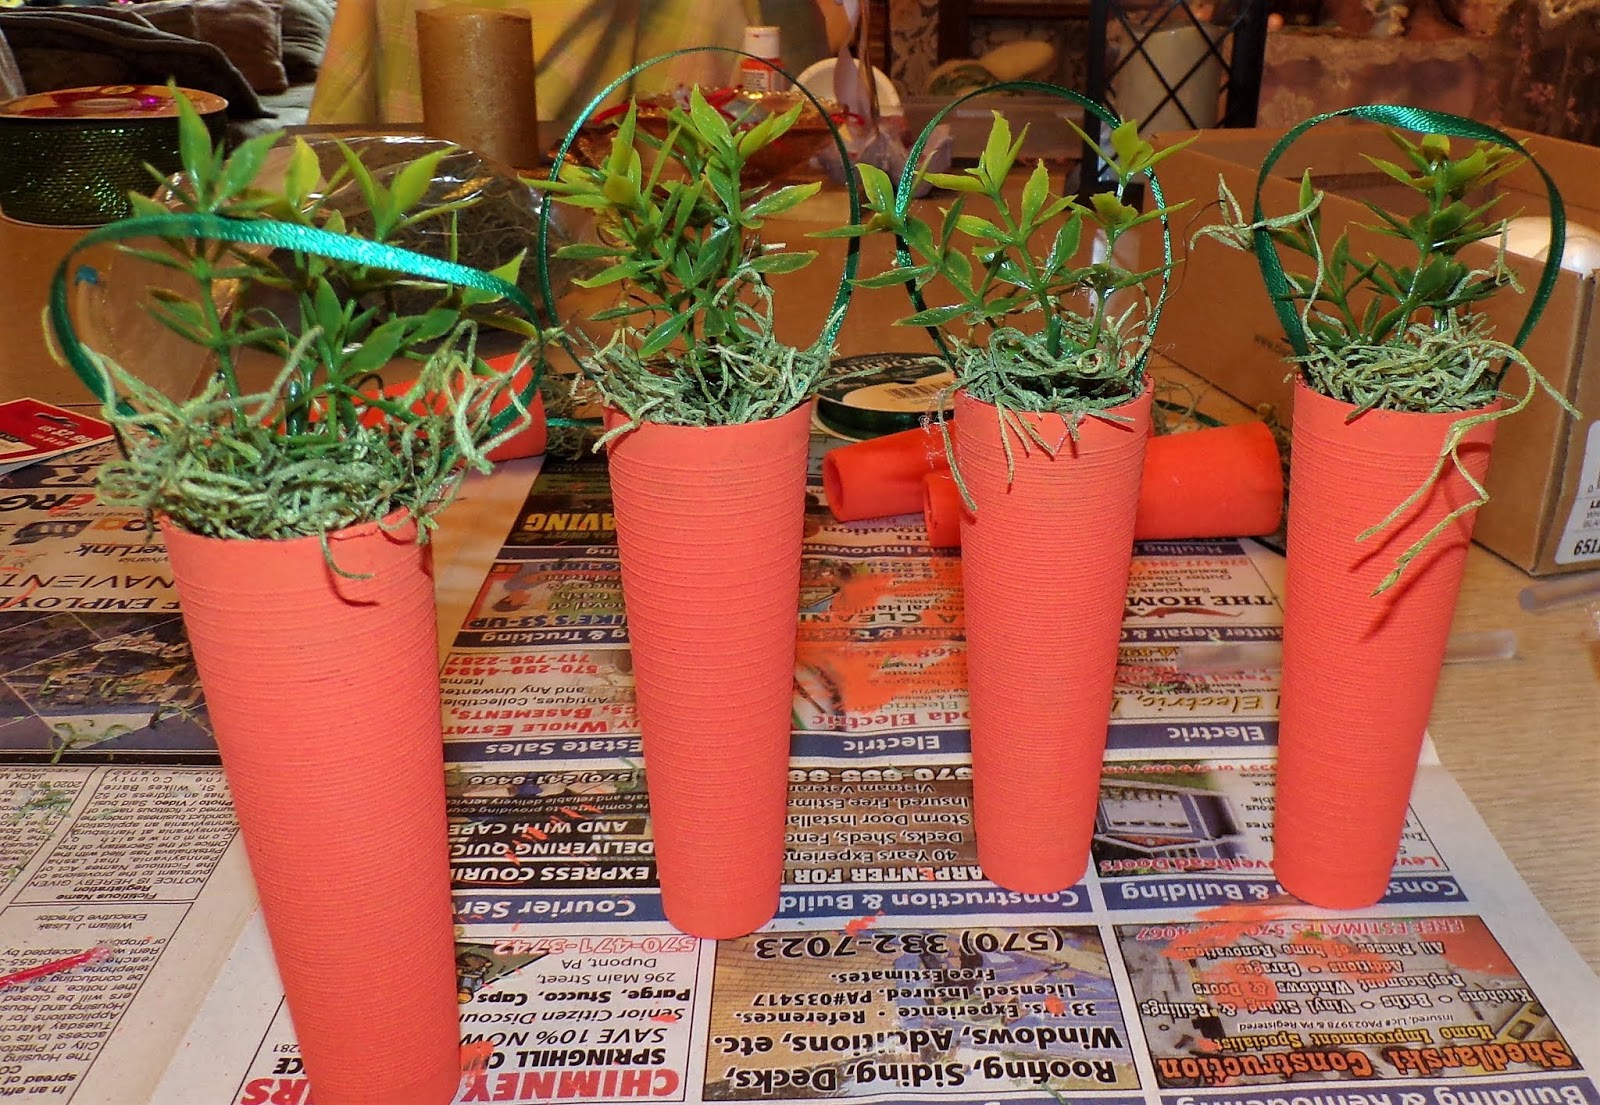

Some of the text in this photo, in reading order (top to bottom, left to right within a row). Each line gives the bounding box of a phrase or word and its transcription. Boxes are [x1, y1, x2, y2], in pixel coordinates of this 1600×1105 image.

[1146, 543, 1222, 554] Hauling
[1210, 595, 1273, 606] THE
[554, 613, 625, 628] IKE'S
[482, 628, 582, 644] Trucking
[1153, 626, 1221, 640] Repair
[520, 684, 585, 695] and Any
[532, 695, 608, 705] Antiques,
[1136, 694, 1264, 713] Electric,
[811, 712, 918, 731] Electric
[1167, 726, 1265, 742] Electric
[483, 738, 644, 757] Estate Sales
[843, 735, 940, 754] Electric
[859, 783, 935, 793] Vietnam
[491, 796, 543, 806] delivery
[850, 796, 968, 809] Insured. Free
[478, 804, 542, 816] providing
[74, 821, 141, 829] application
[862, 813, 970, 826] Storm Door
[158, 826, 236, 835] Pennsylvania
[576, 820, 628, 834] AND
[833, 830, 962, 846] Decks, Sheds,
[95, 842, 154, 851] Secretary
[512, 839, 654, 856] DELIVERING
[129, 854, 220, 862] Pennsylvania,
[878, 850, 957, 863] 40 Years
[134, 862, 191, 870] Fictitious
[1099, 857, 1169, 873] Doors
[50, 868, 211, 879] pursuant provisions
[541, 865, 649, 882] EXPRESS
[793, 867, 843, 884] FOR
[27, 876, 206, 888] NOTICE HEREBY GIVEN
[73, 884, 152, 892] Registration
[1121, 882, 1243, 902] Building
[862, 890, 1079, 912] Construction &
[518, 899, 636, 918] Courier
[34, 913, 148, 922] Executive Director
[37, 922, 133, 931] William Lisak
[1290, 919, 1465, 937] FREE ESTIMATES
[492, 936, 697, 956] 570-471-3742
[754, 929, 1064, 960] (570) 332-7023
[1357, 941, 1445, 955] All Phases
[26, 947, 160, 957] Rent accepted
[81, 964, 149, 974] telephone.
[561, 956, 657, 971] Dupont, PA
[50, 973, 123, 984] conducting
[536, 972, 676, 987] 296 Main Street,
[831, 967, 996, 985] Free Estimates.
[33, 983, 137, 994] ther notice. The
[1191, 972, 1465, 997] Replacement Windows Doors
[2, 992, 132, 1003] ers will closed
[476, 986, 691, 1007] Parge, Stucco, Caps
[752, 984, 1076, 1008] Licensed. Insured. PA#035417
[1140, 987, 1533, 1019] Kitchens Baths Vinyl Siding Railings
[40, 1001, 125, 1013] Housing and
[5, 1011, 119, 1023] Applications for
[540, 1007, 685, 1025] Senior Citizen
[735, 1003, 1097, 1026] 33 Experience References.
[0, 1021, 112, 1032] Tuesday March
[1239, 1020, 1297, 1032] Registered
[16, 1031, 107, 1042] access its
[535, 1027, 667, 1046] SAVE 10%
[960, 1026, 1122, 1051] Windows,
[1213, 1024, 1495, 1052] Home Improvement Specialist
[52, 1041, 99, 1052] City of
[713, 1036, 774, 1057] etc.
[3, 1052, 91, 1063] The Housing
[515, 1048, 666, 1068] SPRINGHILL
[1157, 1040, 1573, 1085] Shedlarski Construction
[24, 1073, 77, 1085] spread
[725, 1056, 1118, 1093] Roofing, Siding, Decks,
[460, 1068, 679, 1104] CHIMNEY
